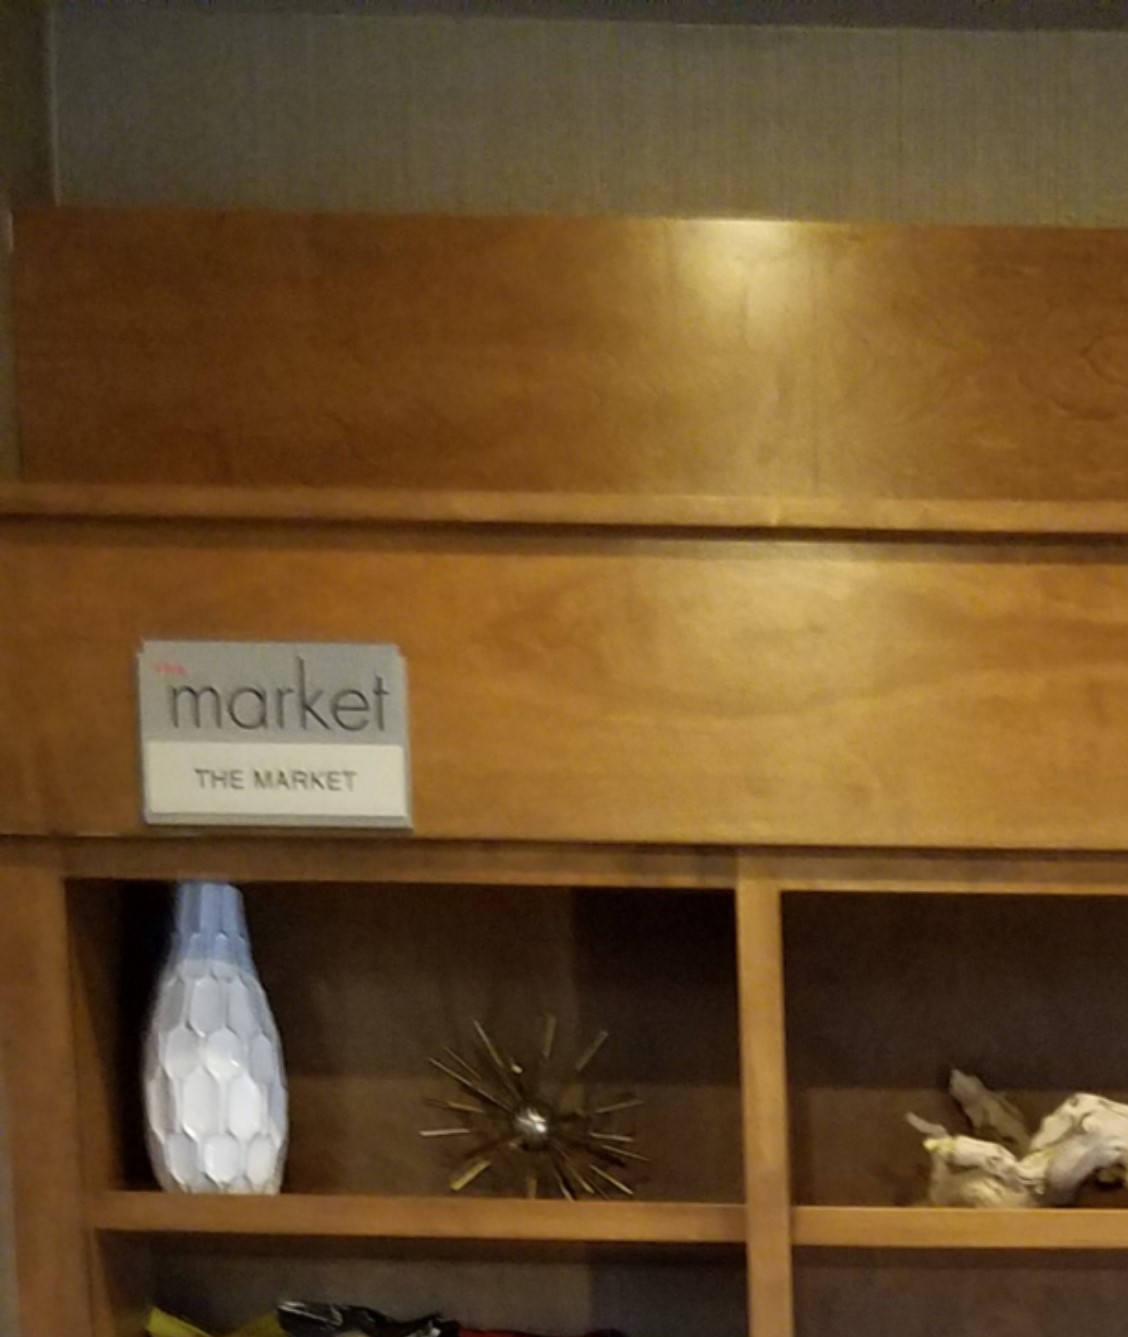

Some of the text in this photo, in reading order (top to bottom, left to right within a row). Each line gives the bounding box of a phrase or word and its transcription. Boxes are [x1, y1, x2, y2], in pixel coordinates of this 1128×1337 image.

[167, 655, 390, 732] market
[195, 768, 358, 793] THE MARKET
